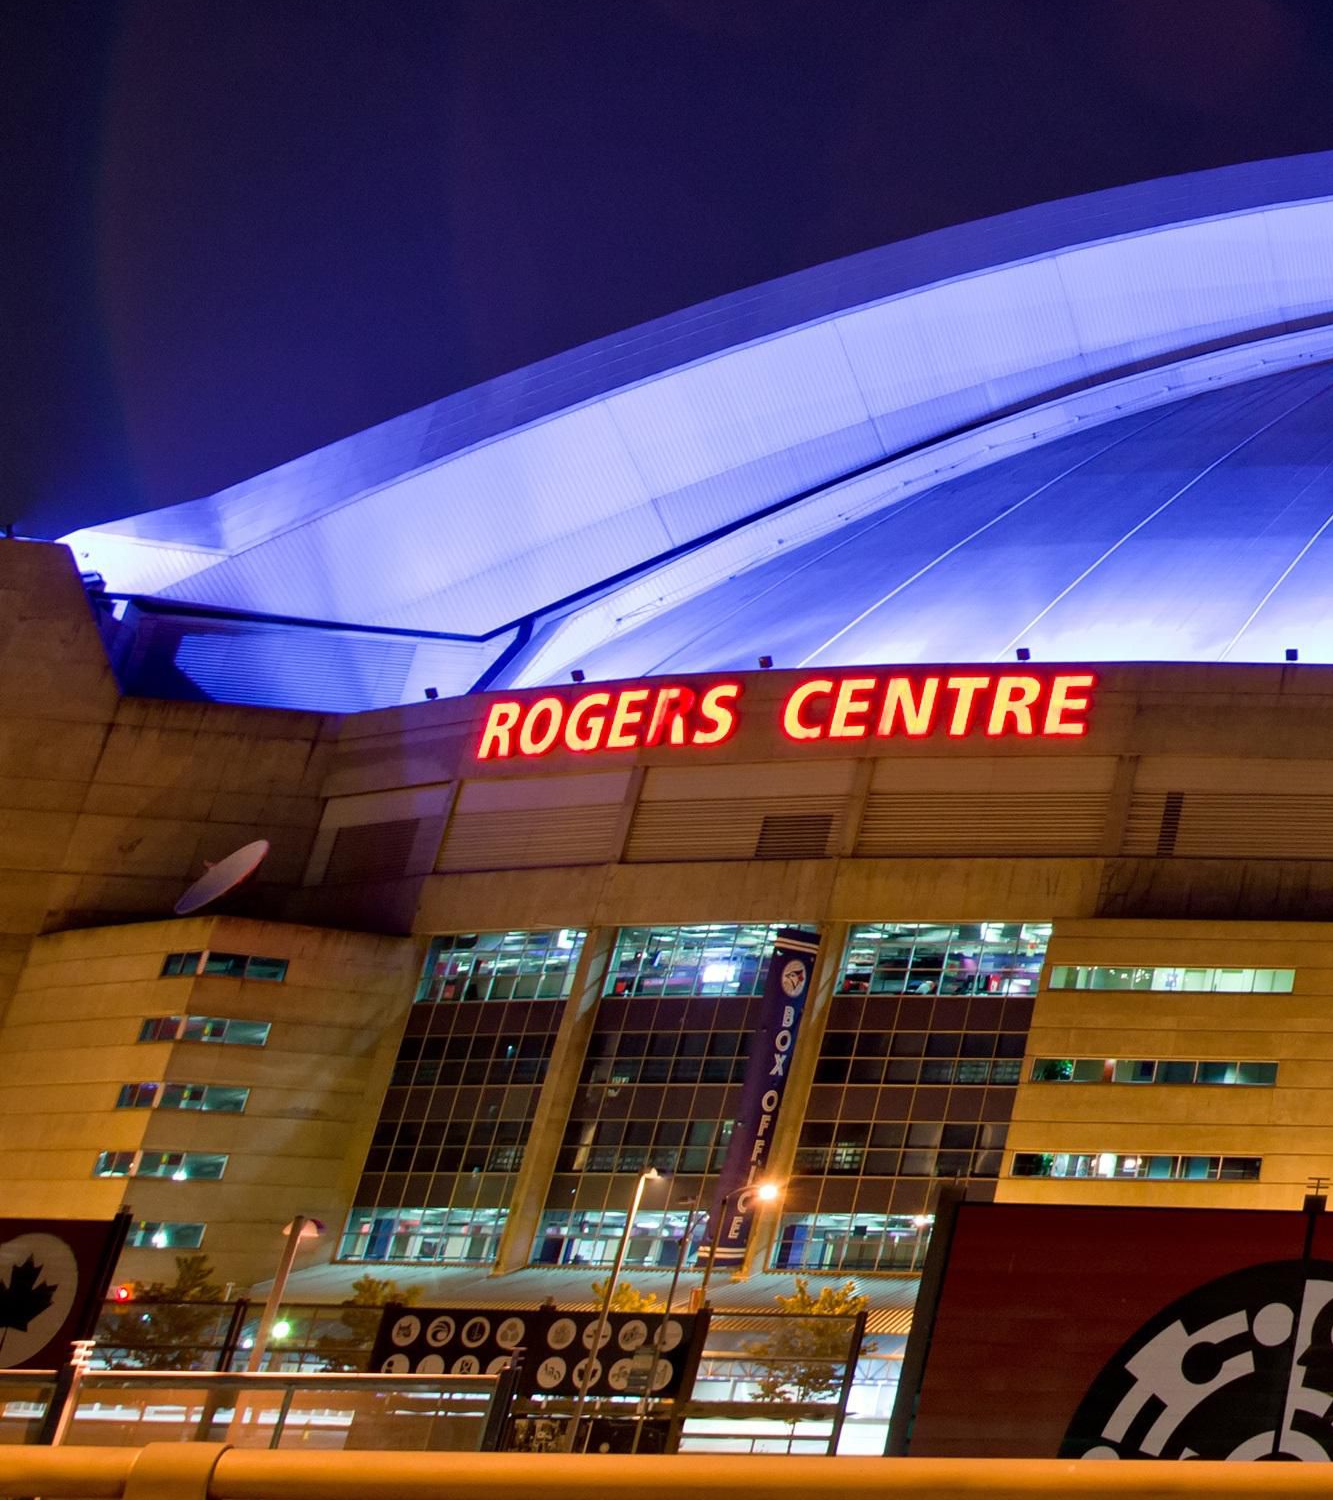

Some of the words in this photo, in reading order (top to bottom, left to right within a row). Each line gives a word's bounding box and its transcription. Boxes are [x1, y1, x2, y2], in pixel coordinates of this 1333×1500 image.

[477, 683, 742, 760] ROGERS
[783, 674, 1095, 741] CENTRE
[769, 1005, 794, 1076] BOX
